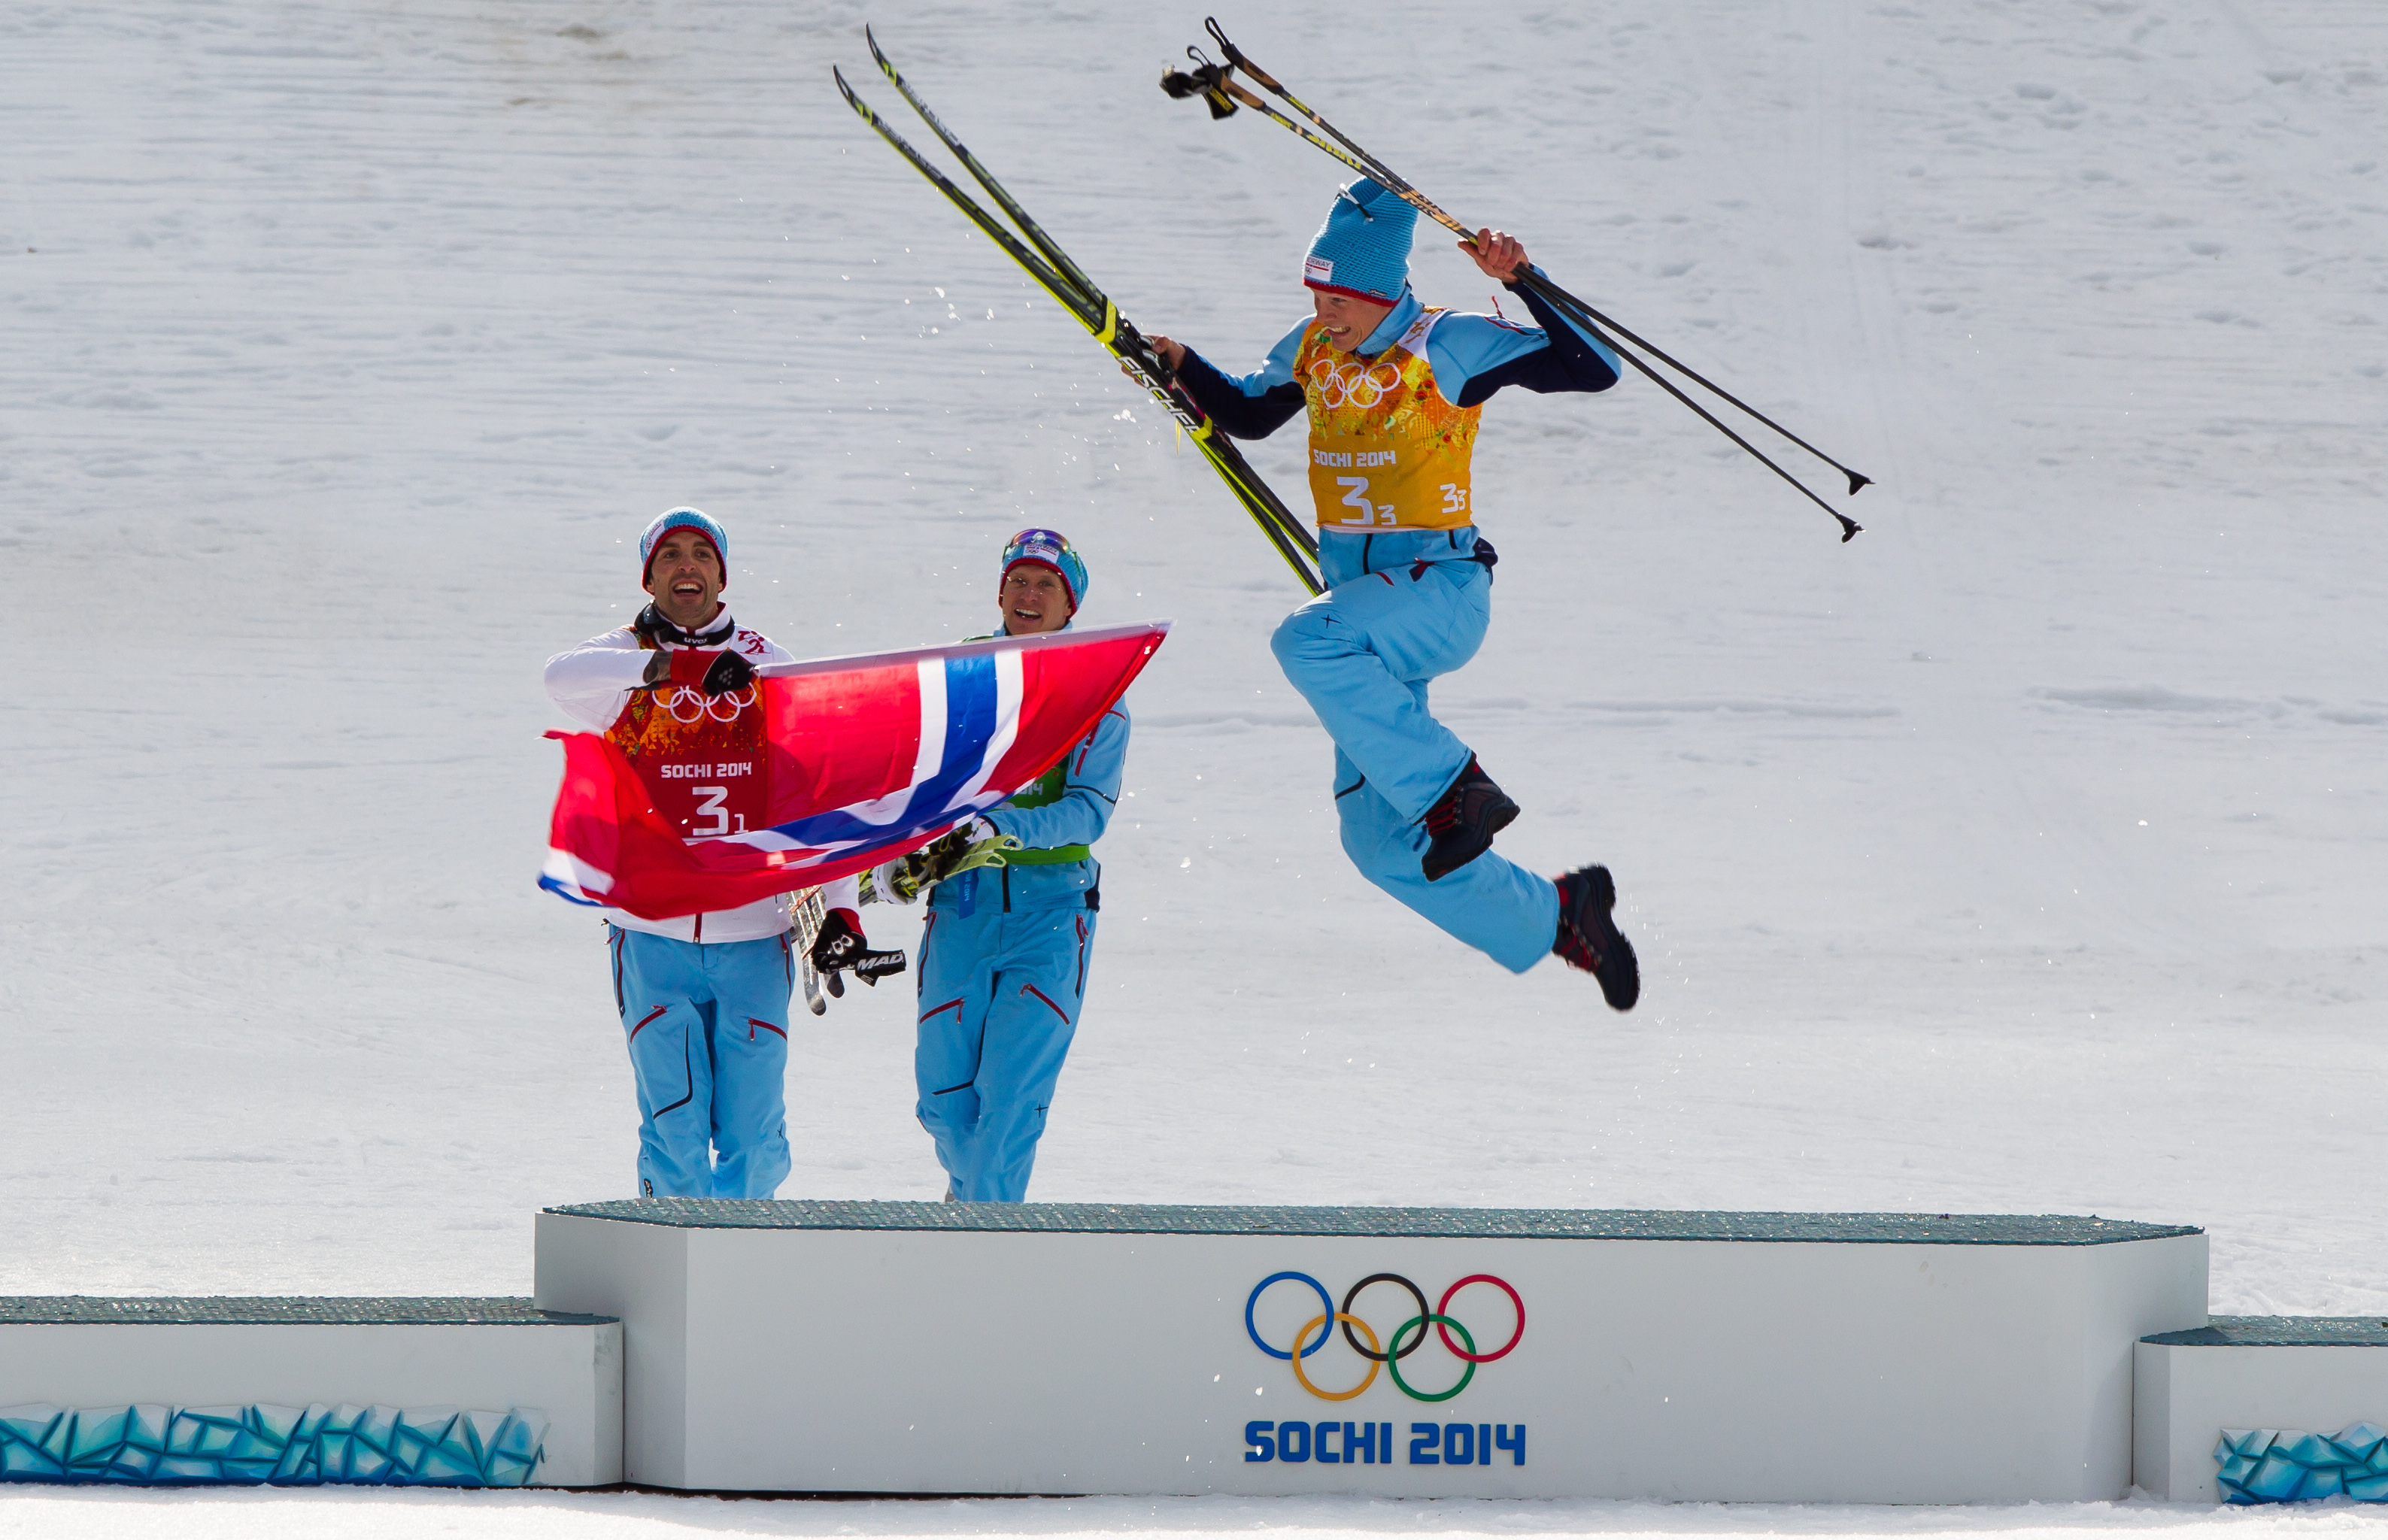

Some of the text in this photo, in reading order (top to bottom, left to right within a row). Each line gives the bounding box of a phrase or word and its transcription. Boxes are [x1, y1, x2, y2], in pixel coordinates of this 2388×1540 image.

[1313, 449, 1397, 468] SOCHI 2014
[660, 761, 752, 778] SOCHI 2014
[1245, 1420, 1526, 1466] SOCHI 2014
